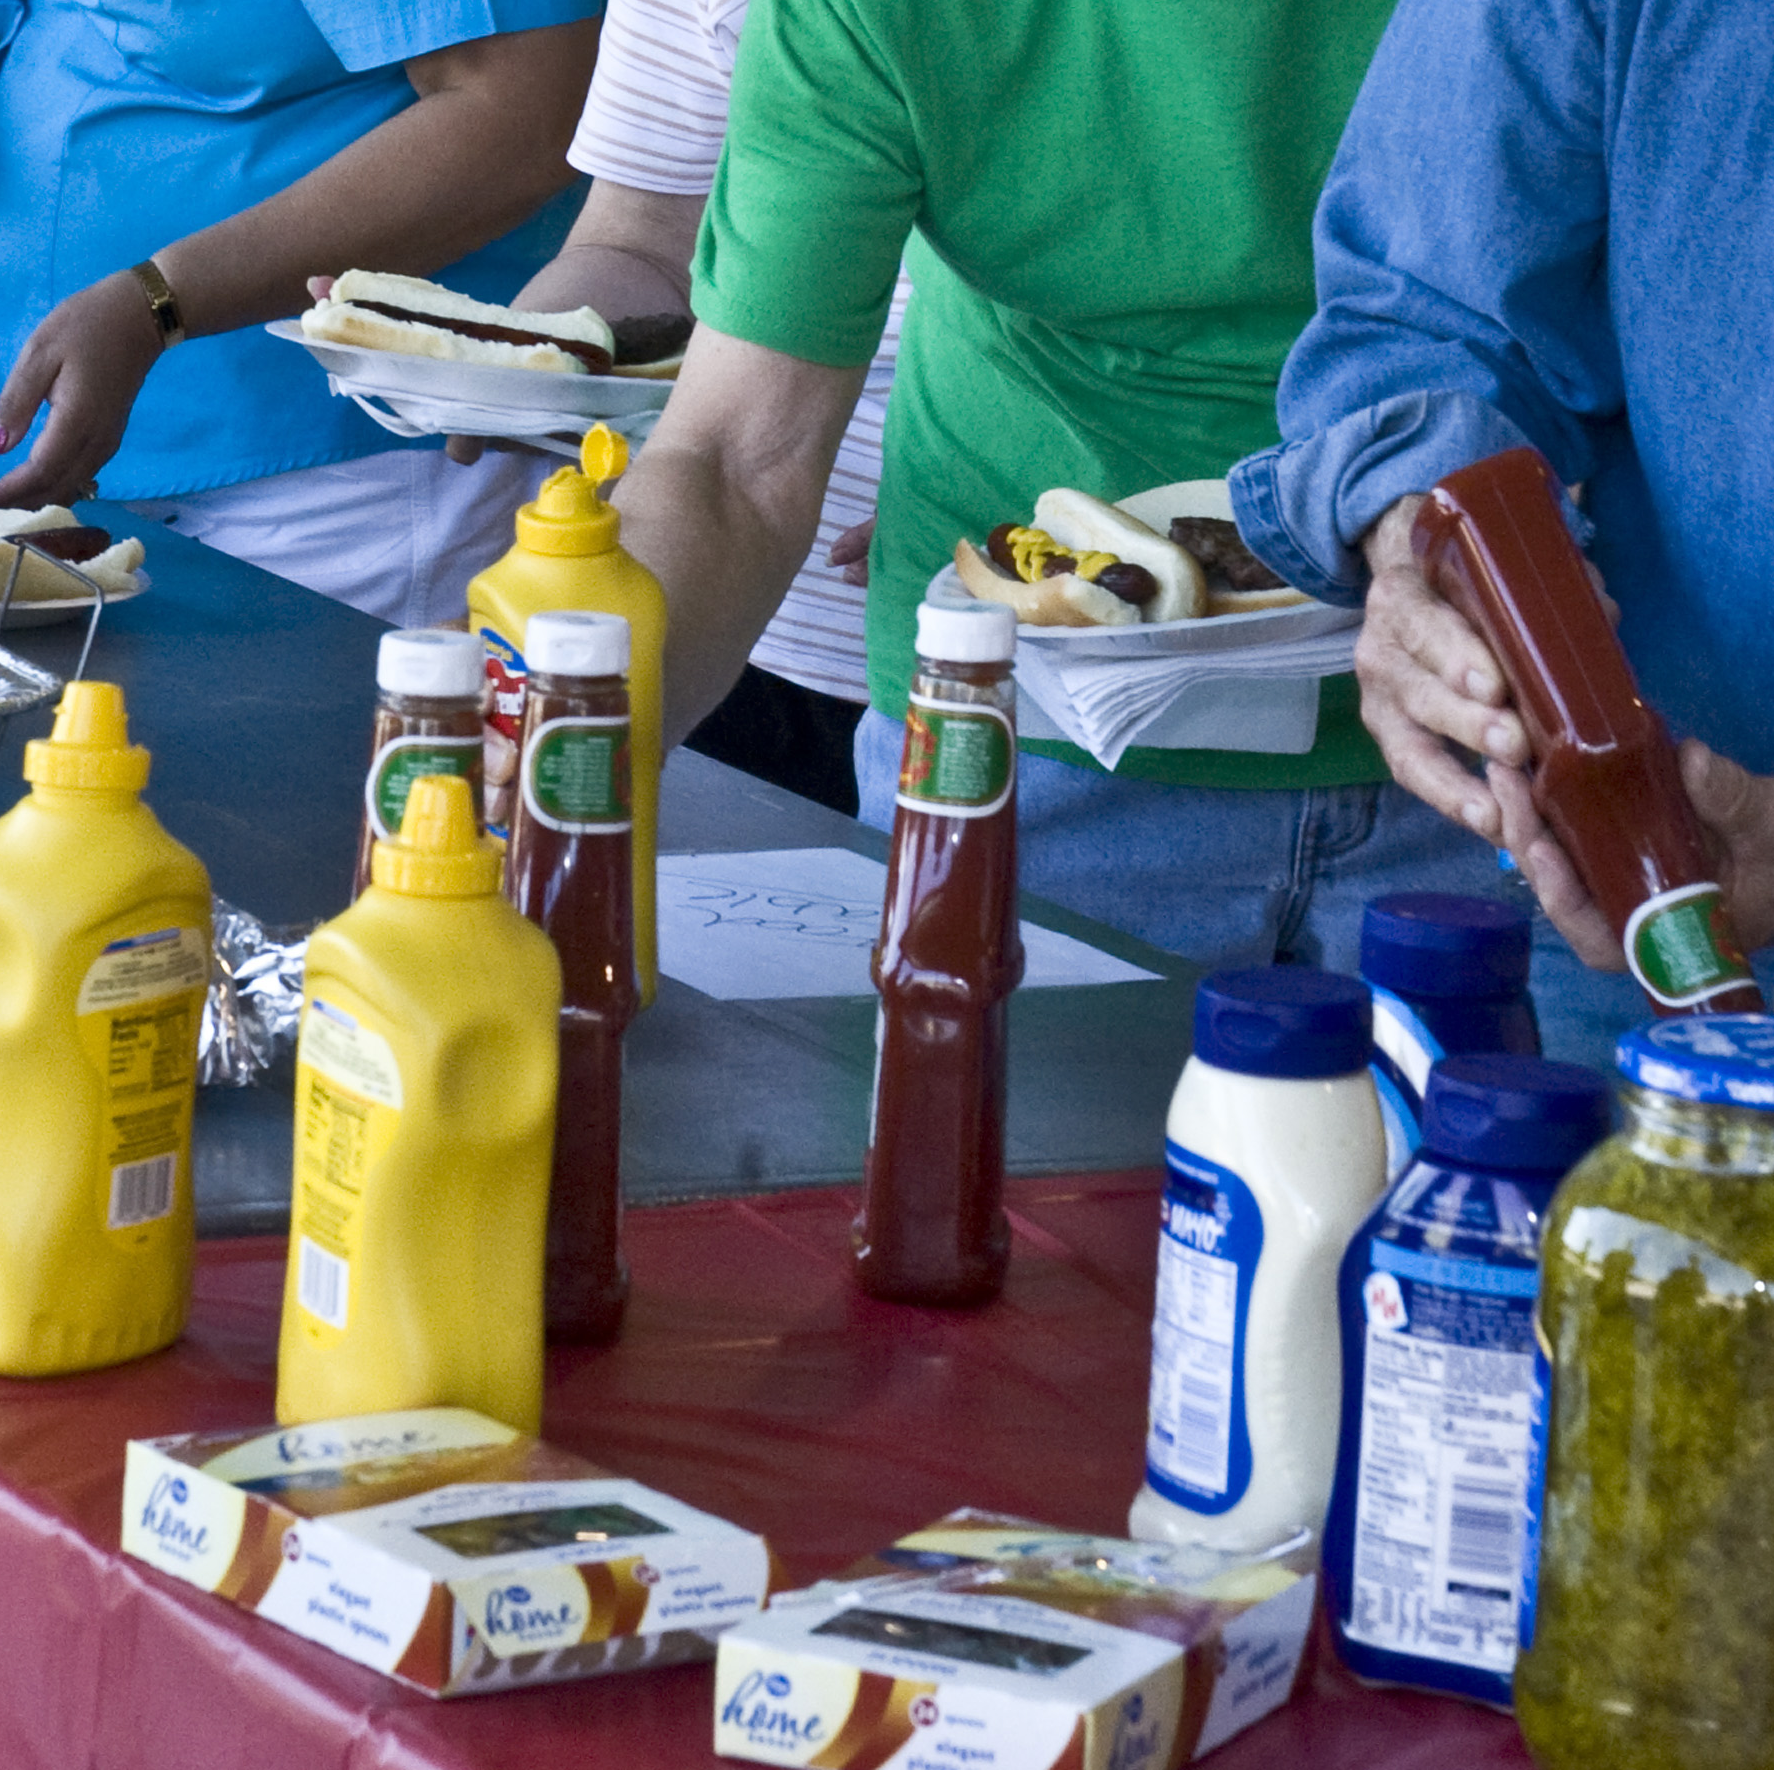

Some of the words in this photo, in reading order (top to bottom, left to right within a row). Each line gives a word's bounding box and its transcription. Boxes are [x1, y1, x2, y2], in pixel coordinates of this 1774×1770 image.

[141, 1471, 211, 1556] home
[485, 1587, 582, 1637] home
[721, 1668, 826, 1743] home
